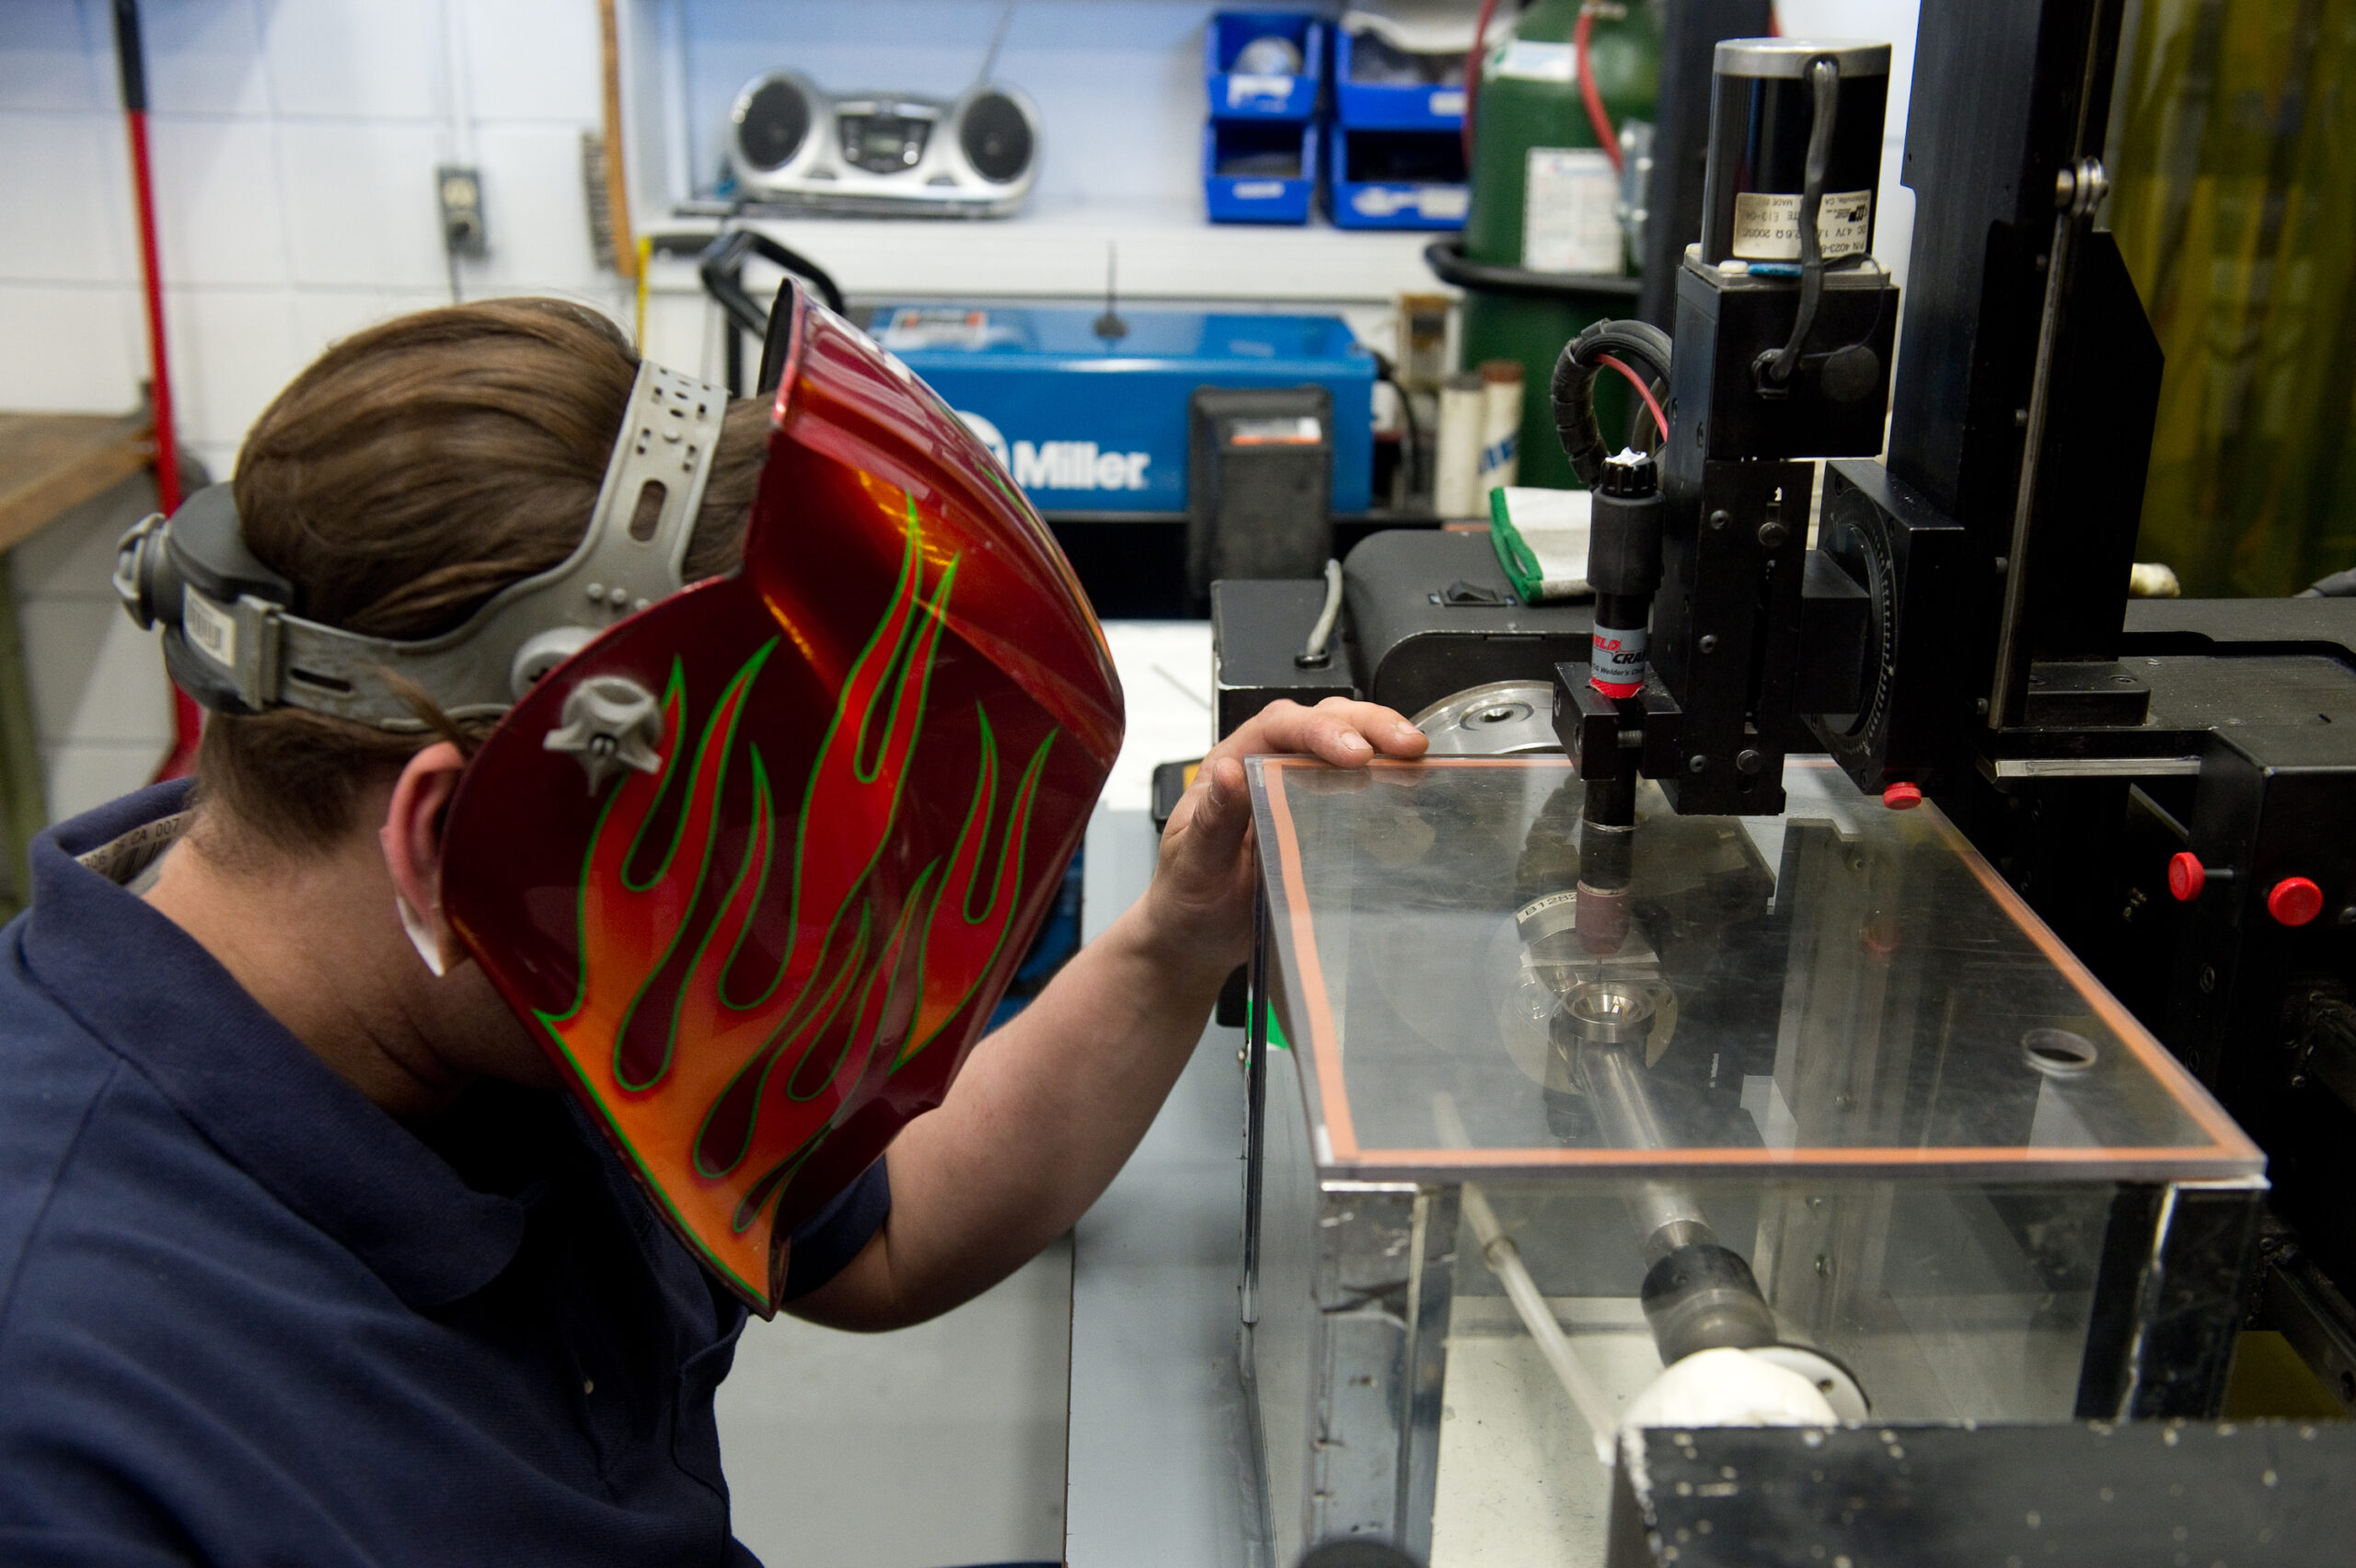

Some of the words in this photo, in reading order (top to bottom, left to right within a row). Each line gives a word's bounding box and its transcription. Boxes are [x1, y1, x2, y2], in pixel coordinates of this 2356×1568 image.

[1773, 198, 1793, 206] MADE
[1012, 440, 1150, 490] Miller
[1593, 634, 1622, 651] ELD
[1612, 651, 1646, 664] CRA
[156, 817, 180, 837] 007
